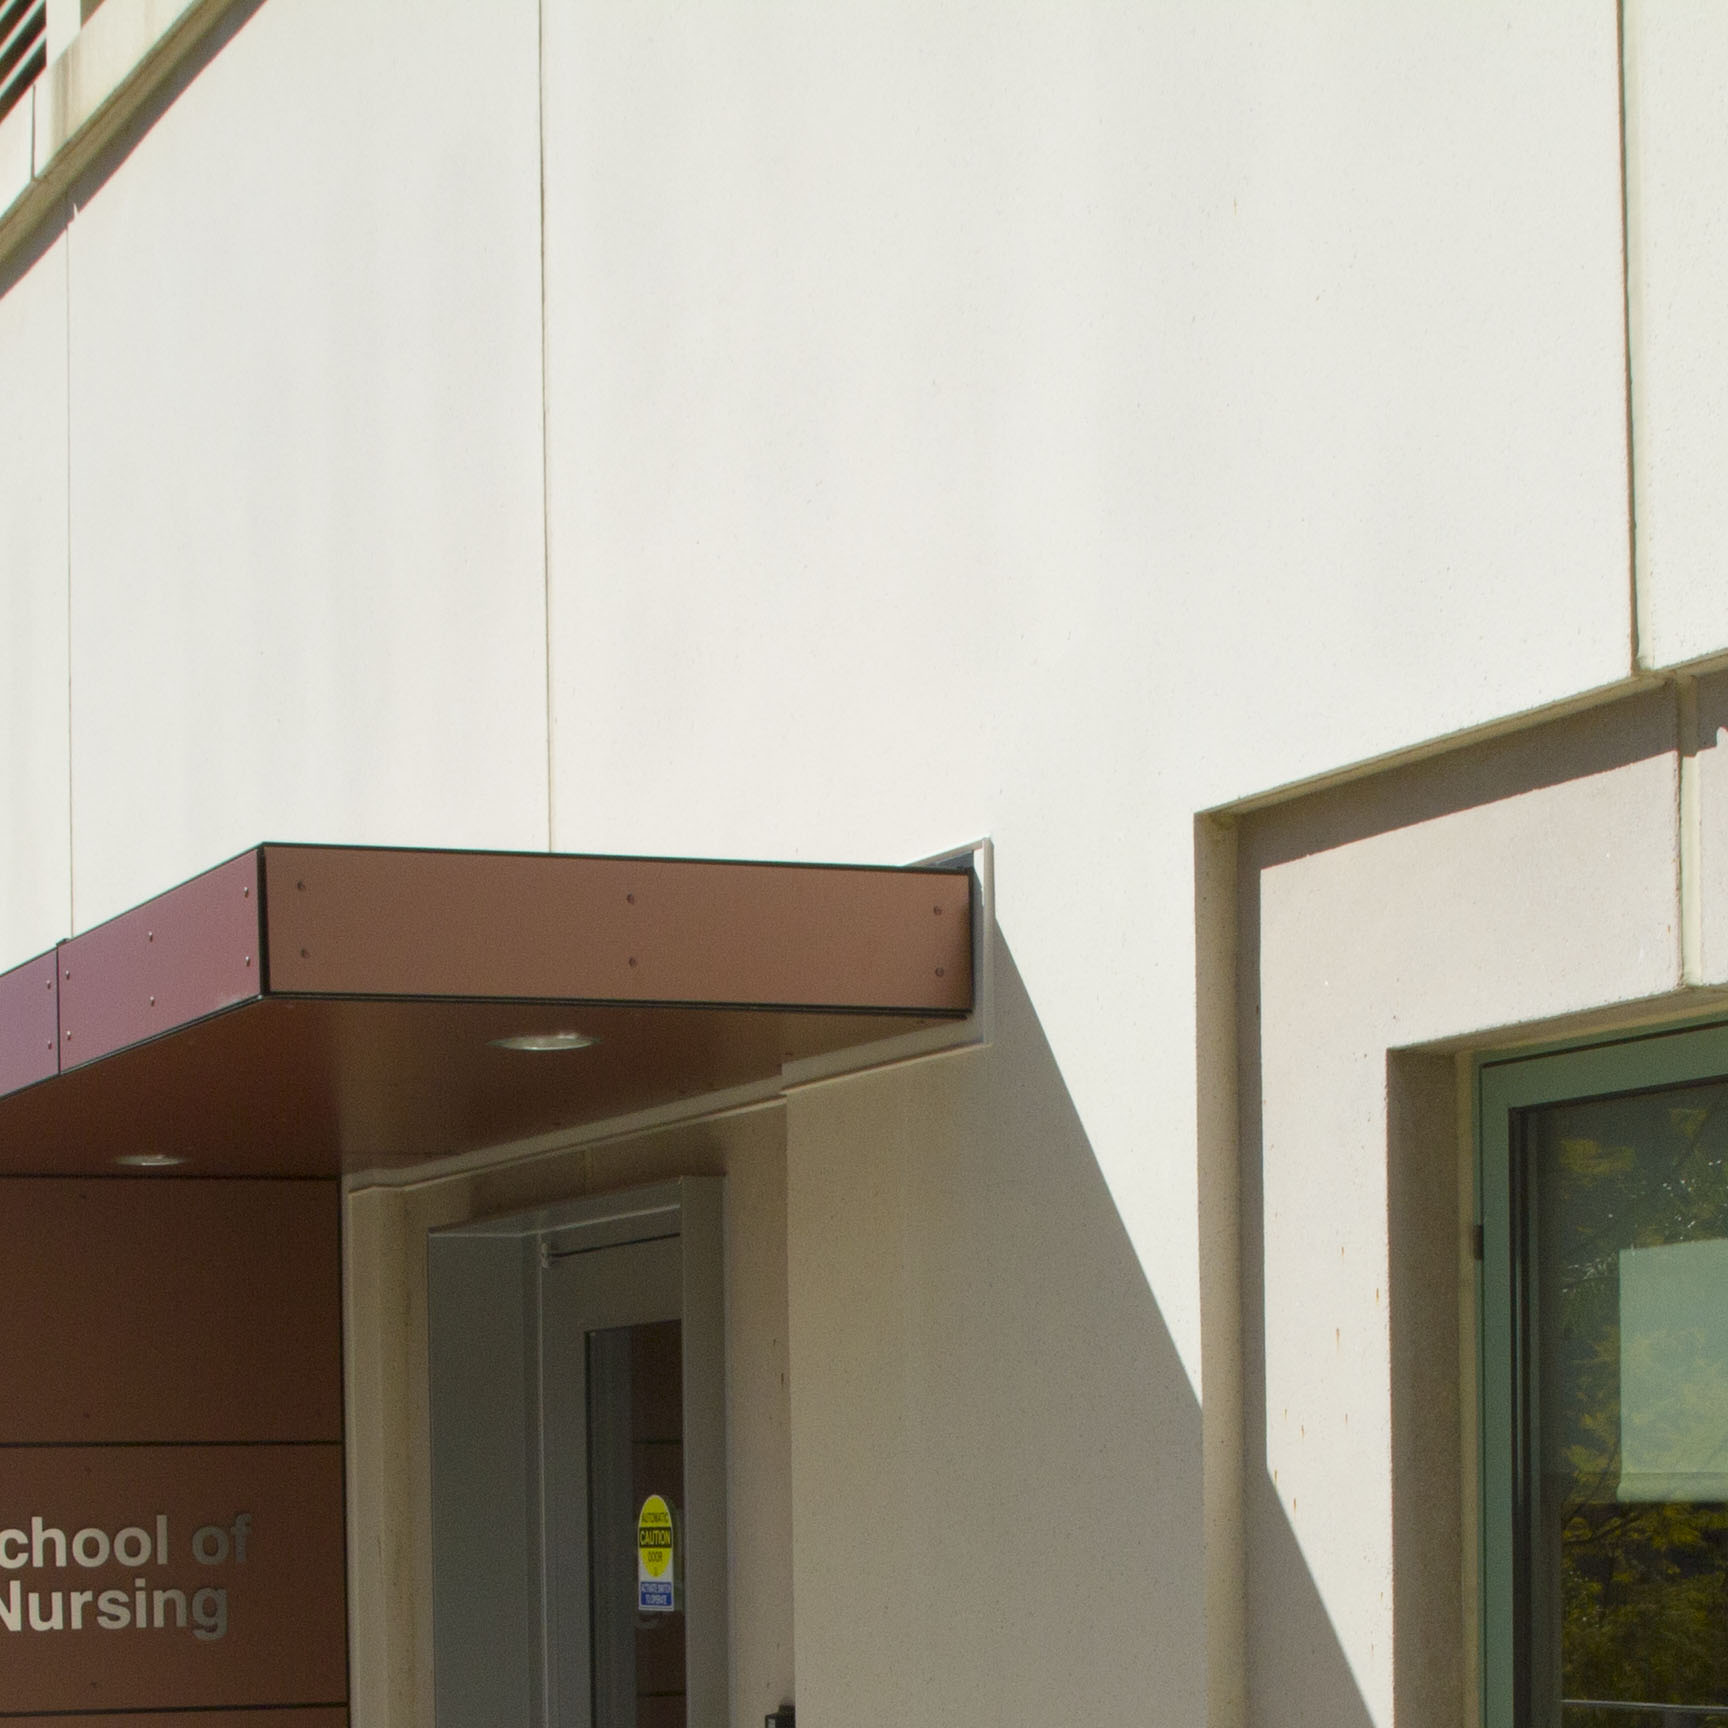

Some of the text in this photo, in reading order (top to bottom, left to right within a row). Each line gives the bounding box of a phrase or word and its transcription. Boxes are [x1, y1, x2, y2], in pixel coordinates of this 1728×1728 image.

[641, 1512, 669, 1523] AUTOMATIC
[192, 1513, 252, 1566] of
[640, 1530, 671, 1545] CAUTION
[647, 1551, 663, 1562] DOOR
